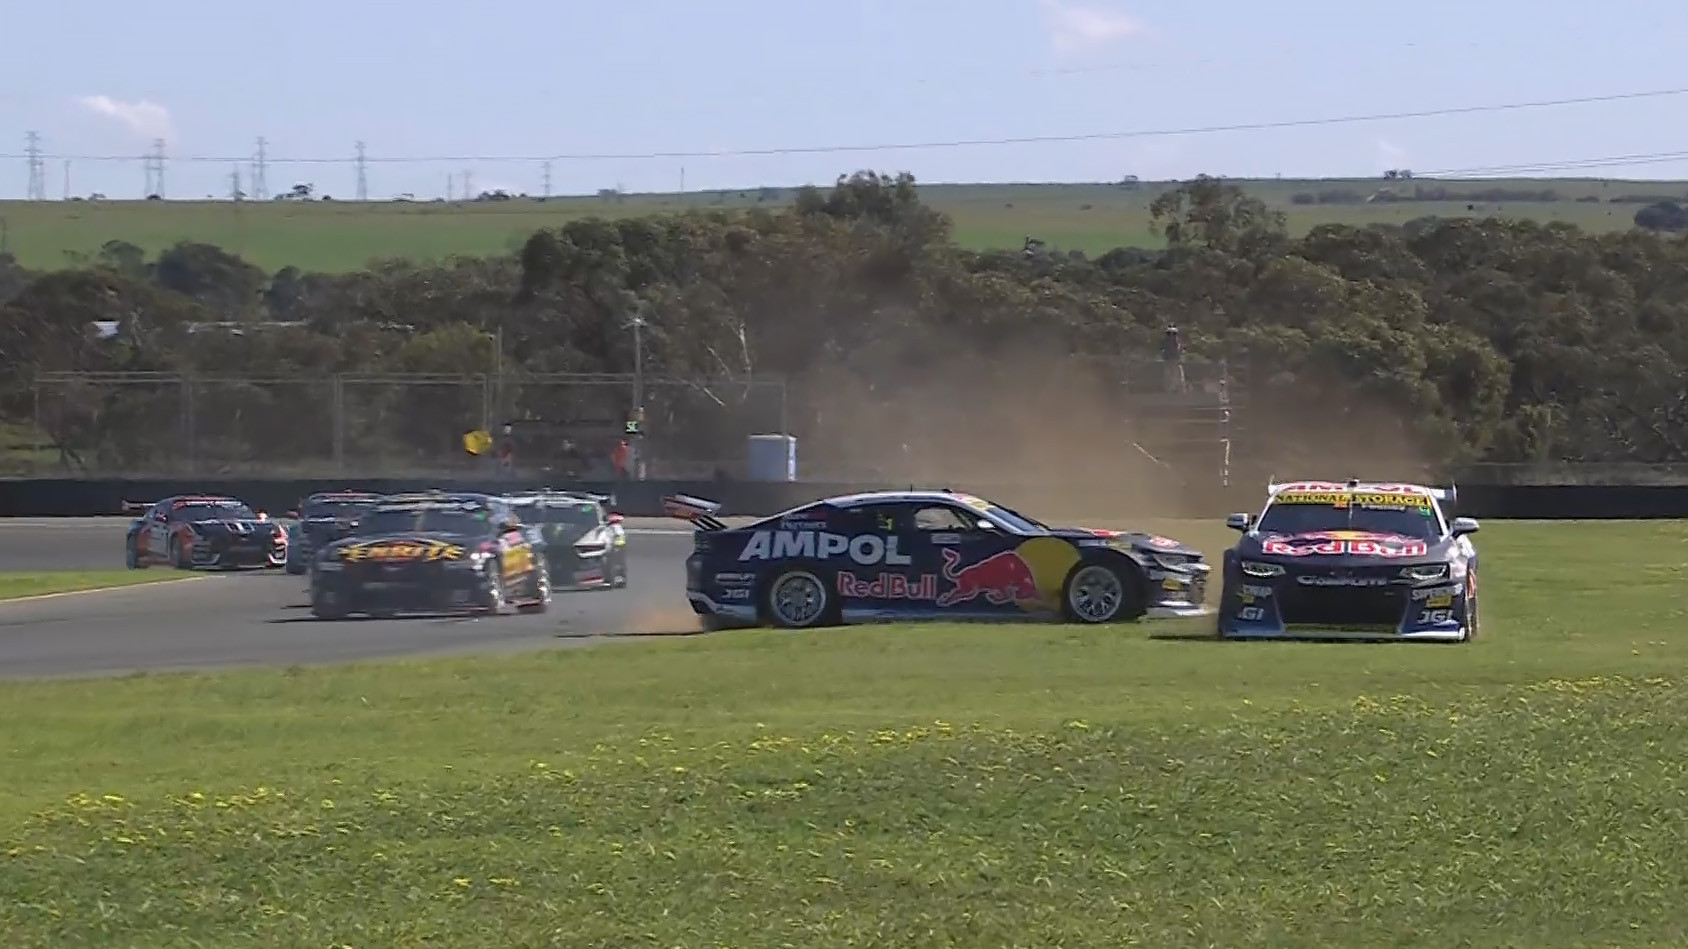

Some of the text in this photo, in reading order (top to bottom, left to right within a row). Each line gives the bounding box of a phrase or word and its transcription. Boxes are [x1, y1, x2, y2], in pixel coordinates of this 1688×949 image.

[1276, 493, 1347, 503] NATIONAL
[738, 531, 911, 565] AMPOL
[1417, 610, 1453, 623] JGI
